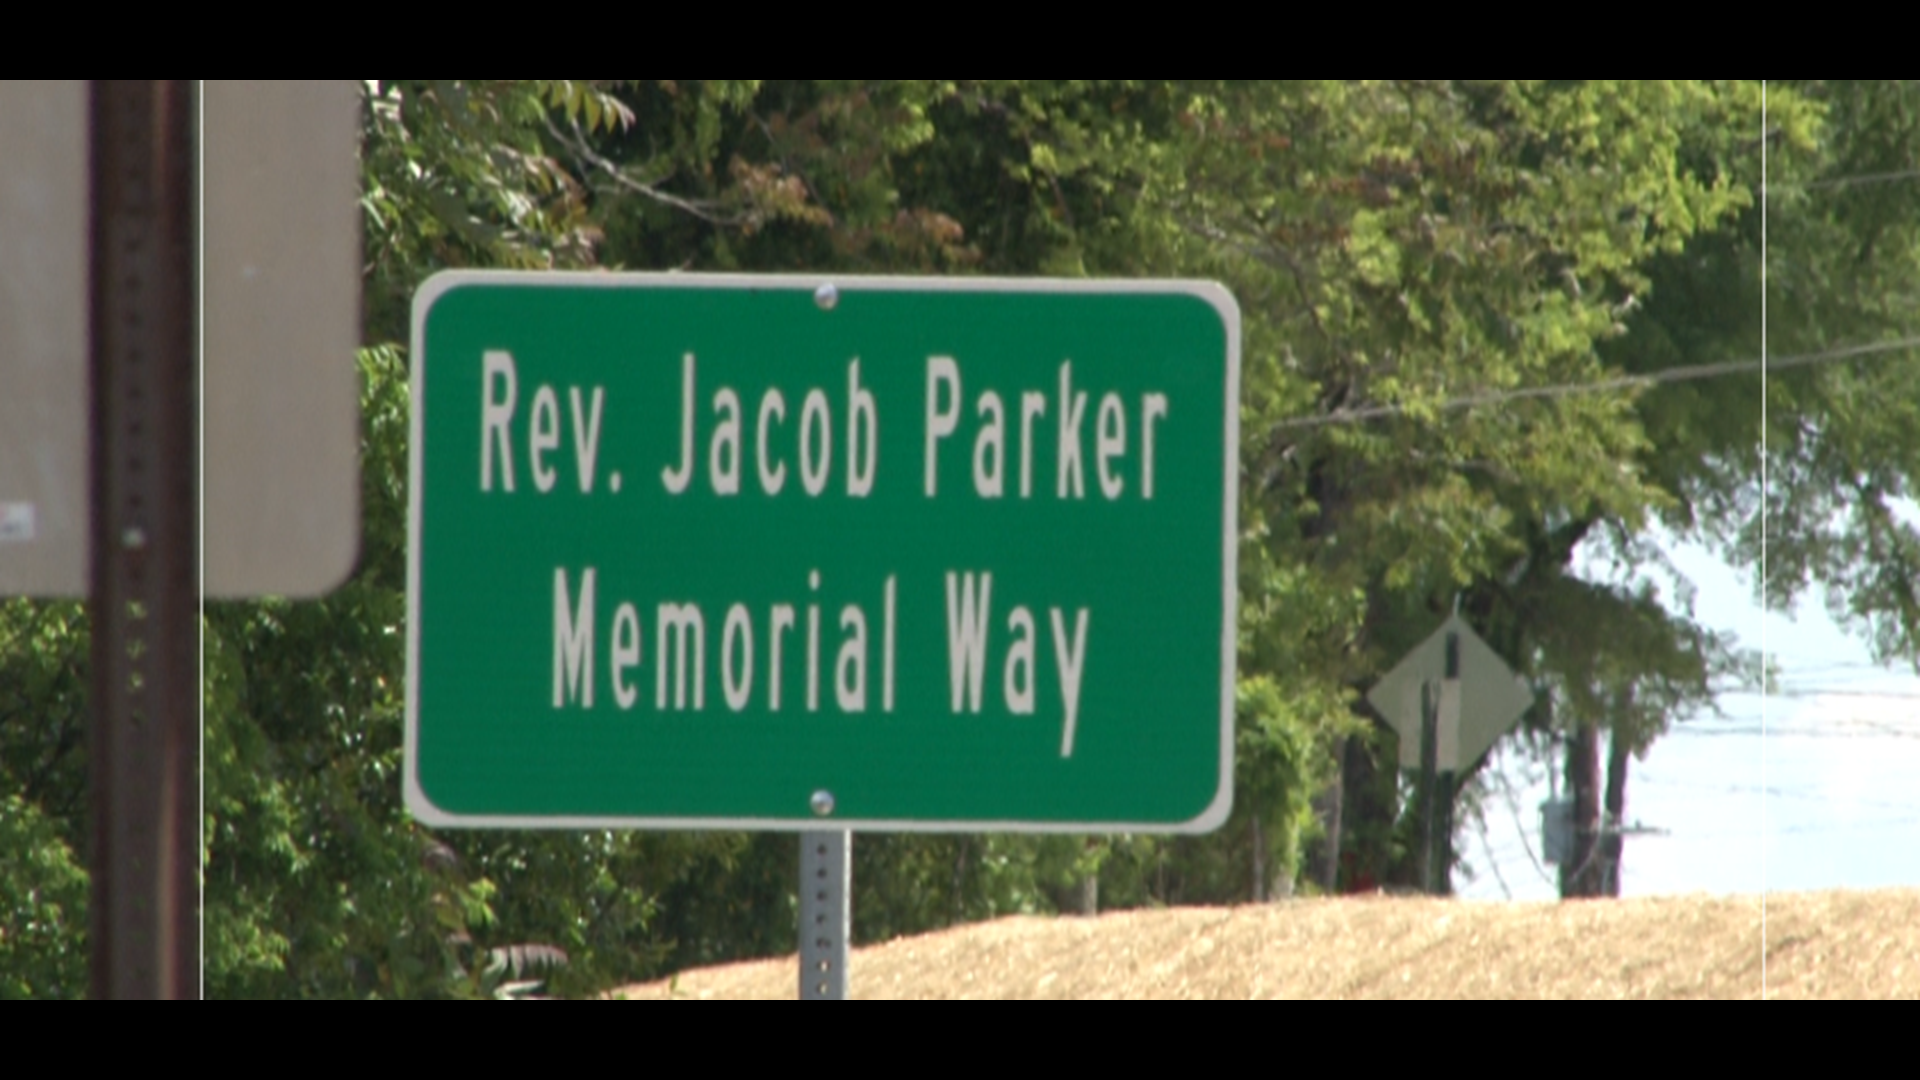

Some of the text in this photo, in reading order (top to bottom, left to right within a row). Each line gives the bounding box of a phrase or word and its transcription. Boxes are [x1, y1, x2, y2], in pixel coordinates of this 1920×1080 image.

[480, 349, 1168, 500] Rev. Jacob Parker
[551, 567, 1089, 757] Memorial Way
